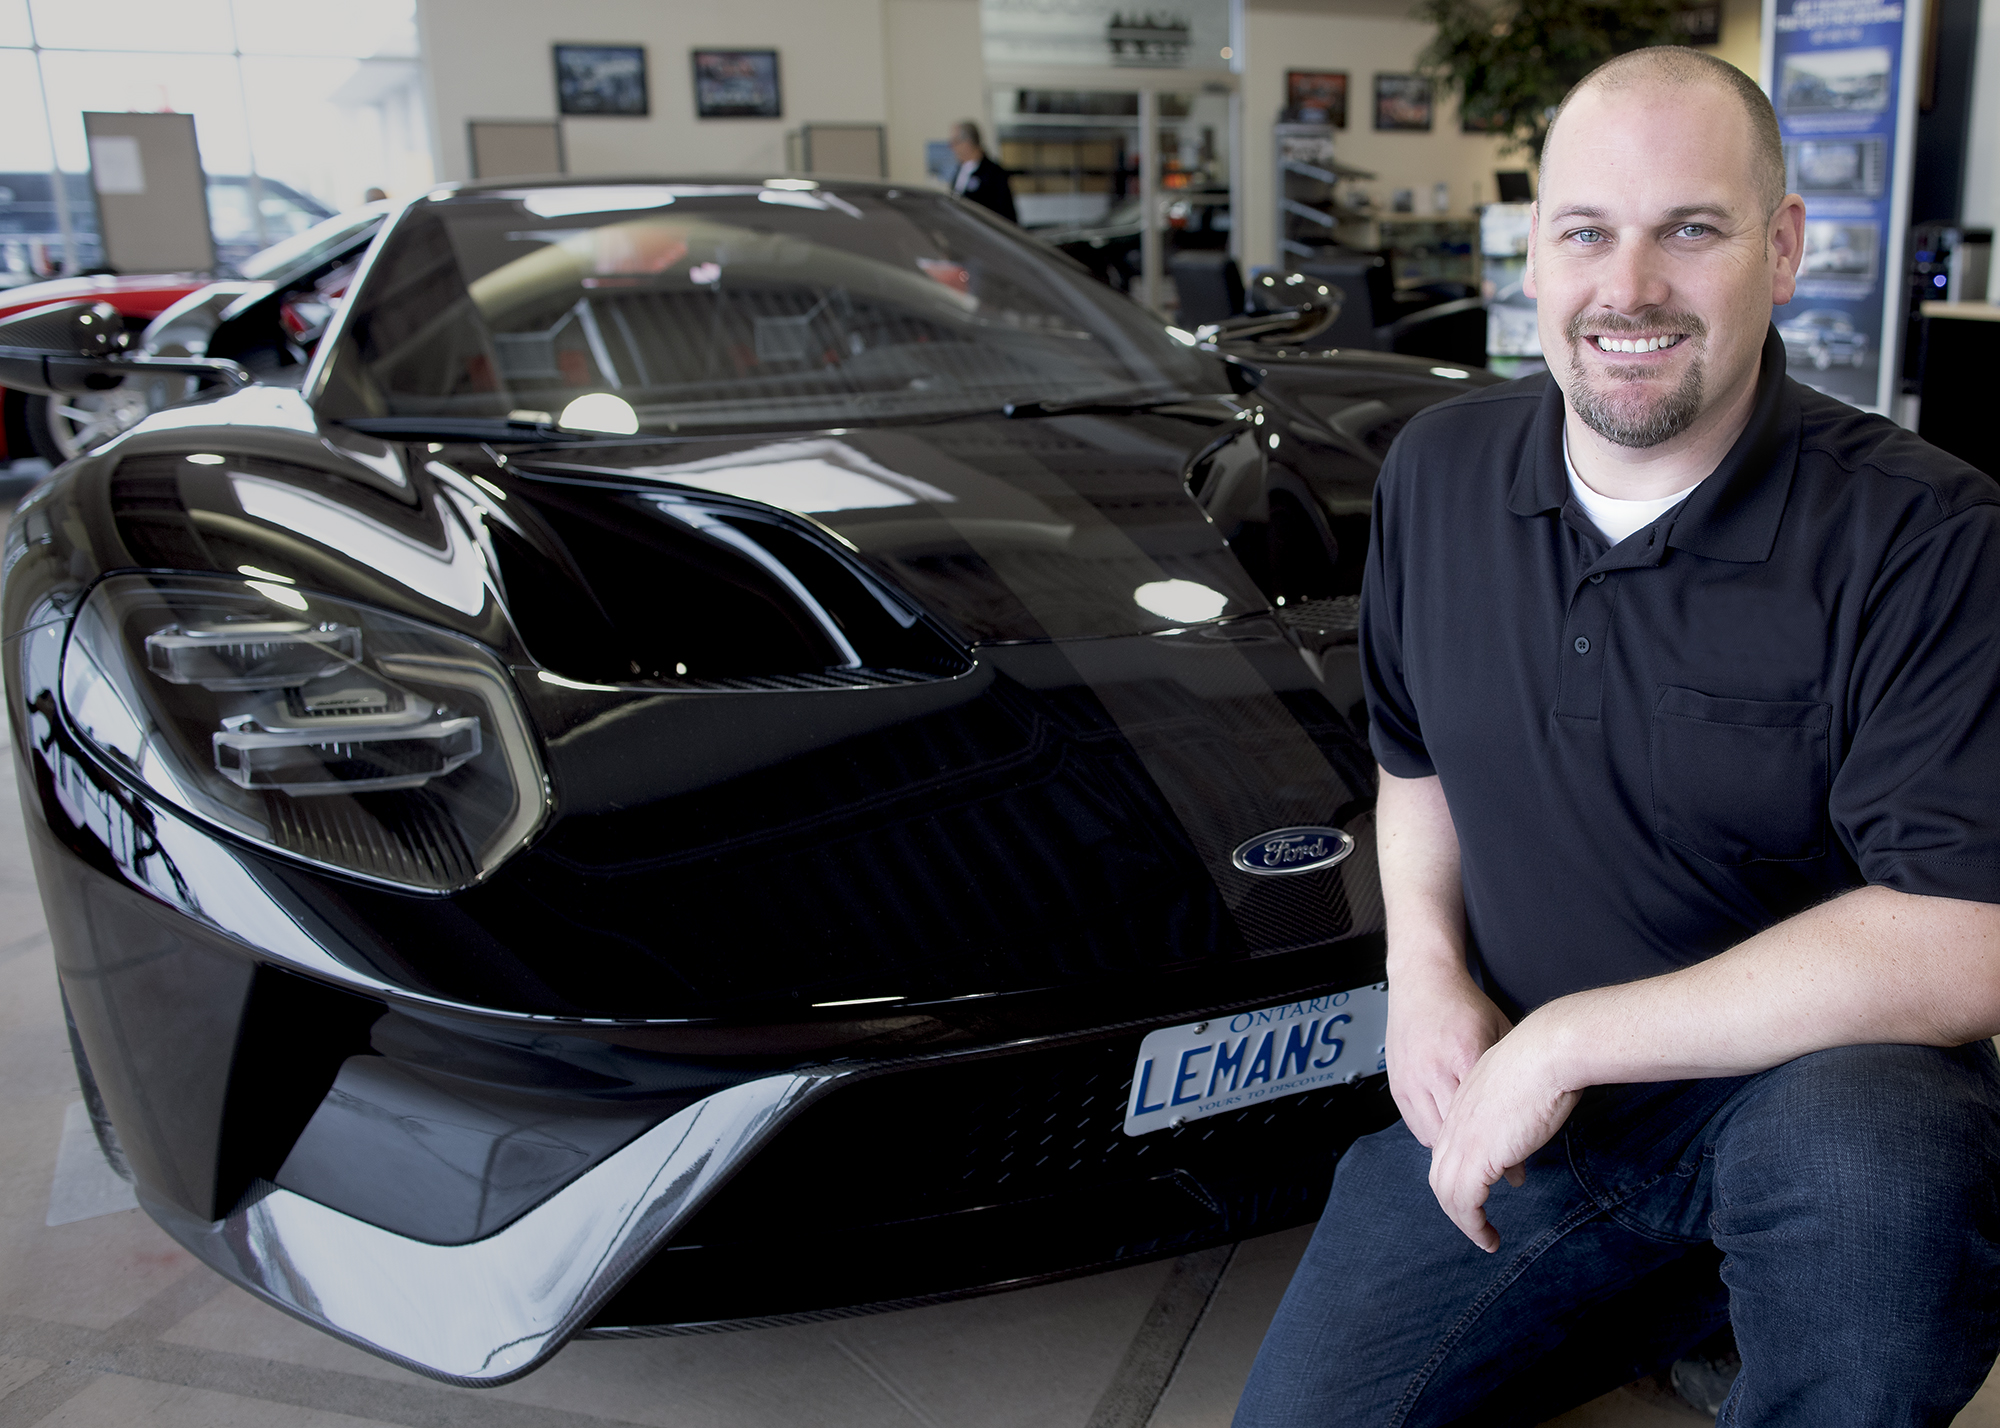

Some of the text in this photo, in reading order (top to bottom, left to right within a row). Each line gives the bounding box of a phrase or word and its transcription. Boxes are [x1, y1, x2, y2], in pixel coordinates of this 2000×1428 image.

[1264, 836, 1328, 866] Ford
[1229, 992, 1350, 1033] ONTARIO
[1133, 1014, 1352, 1116] LEMANS
[1248, 1089, 1266, 1100] TO
[1269, 1072, 1335, 1094] DISCOVER
[1198, 1095, 1242, 1112] YOURS
